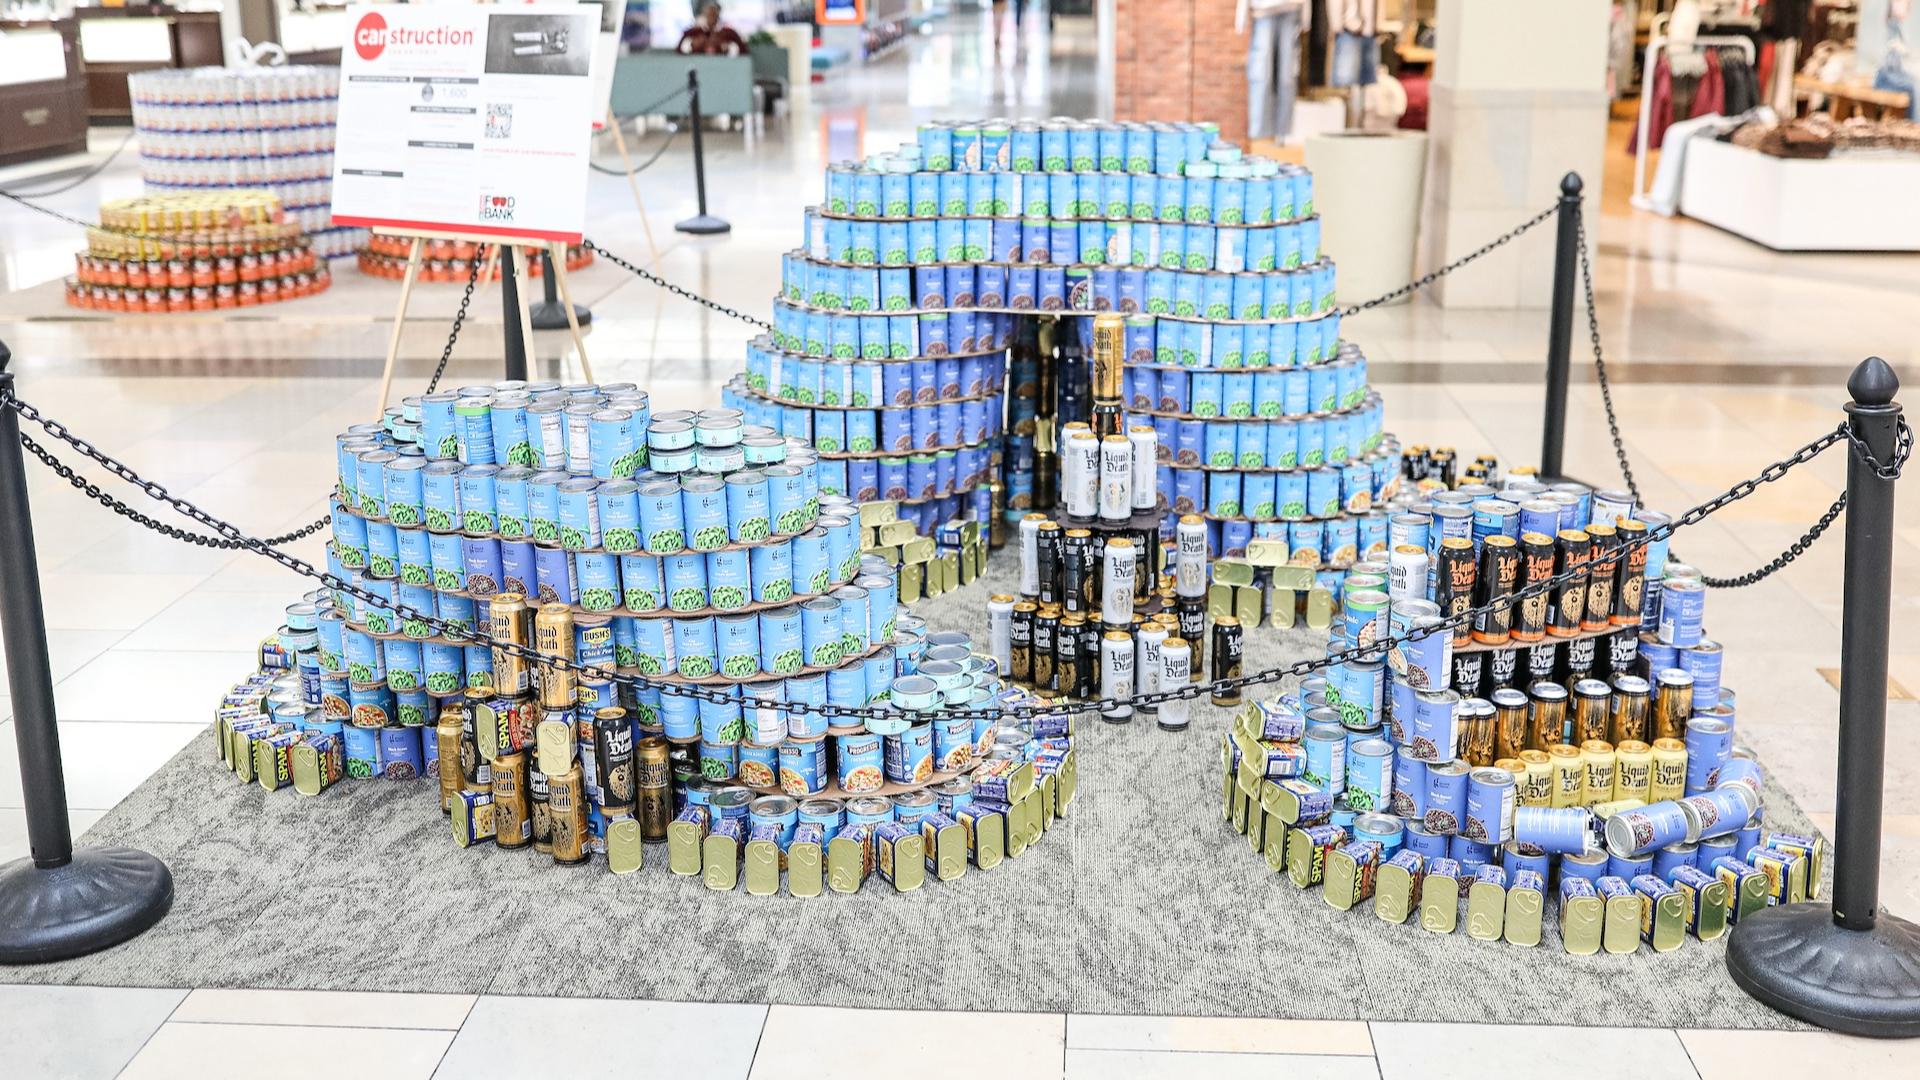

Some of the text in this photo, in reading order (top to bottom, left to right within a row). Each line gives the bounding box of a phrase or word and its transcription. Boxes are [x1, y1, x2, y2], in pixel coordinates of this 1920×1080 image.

[485, 208, 514, 220] BANK
[1105, 451, 1129, 466] Liquid
[1106, 461, 1128, 472] Death
[1181, 532, 1204, 546] Liquid
[1182, 542, 1204, 552] Death
[1112, 556, 1134, 571] Liqui
[584, 629, 609, 642] BUSH'S
[1111, 650, 1133, 665] Liqui
[1163, 656, 1188, 671] Liquid
[1165, 667, 1188, 678] Death
[498, 710, 509, 749] SPAM
[277, 746, 288, 781] SPAM
[319, 751, 329, 787] SPAM
[1620, 762, 1649, 778] Liquid
[1655, 760, 1684, 777] Liquid
[1621, 775, 1648, 787] Death
[1656, 772, 1683, 785] Death
[1312, 846, 1324, 883] SPAM
[1354, 865, 1364, 904] SPAM
